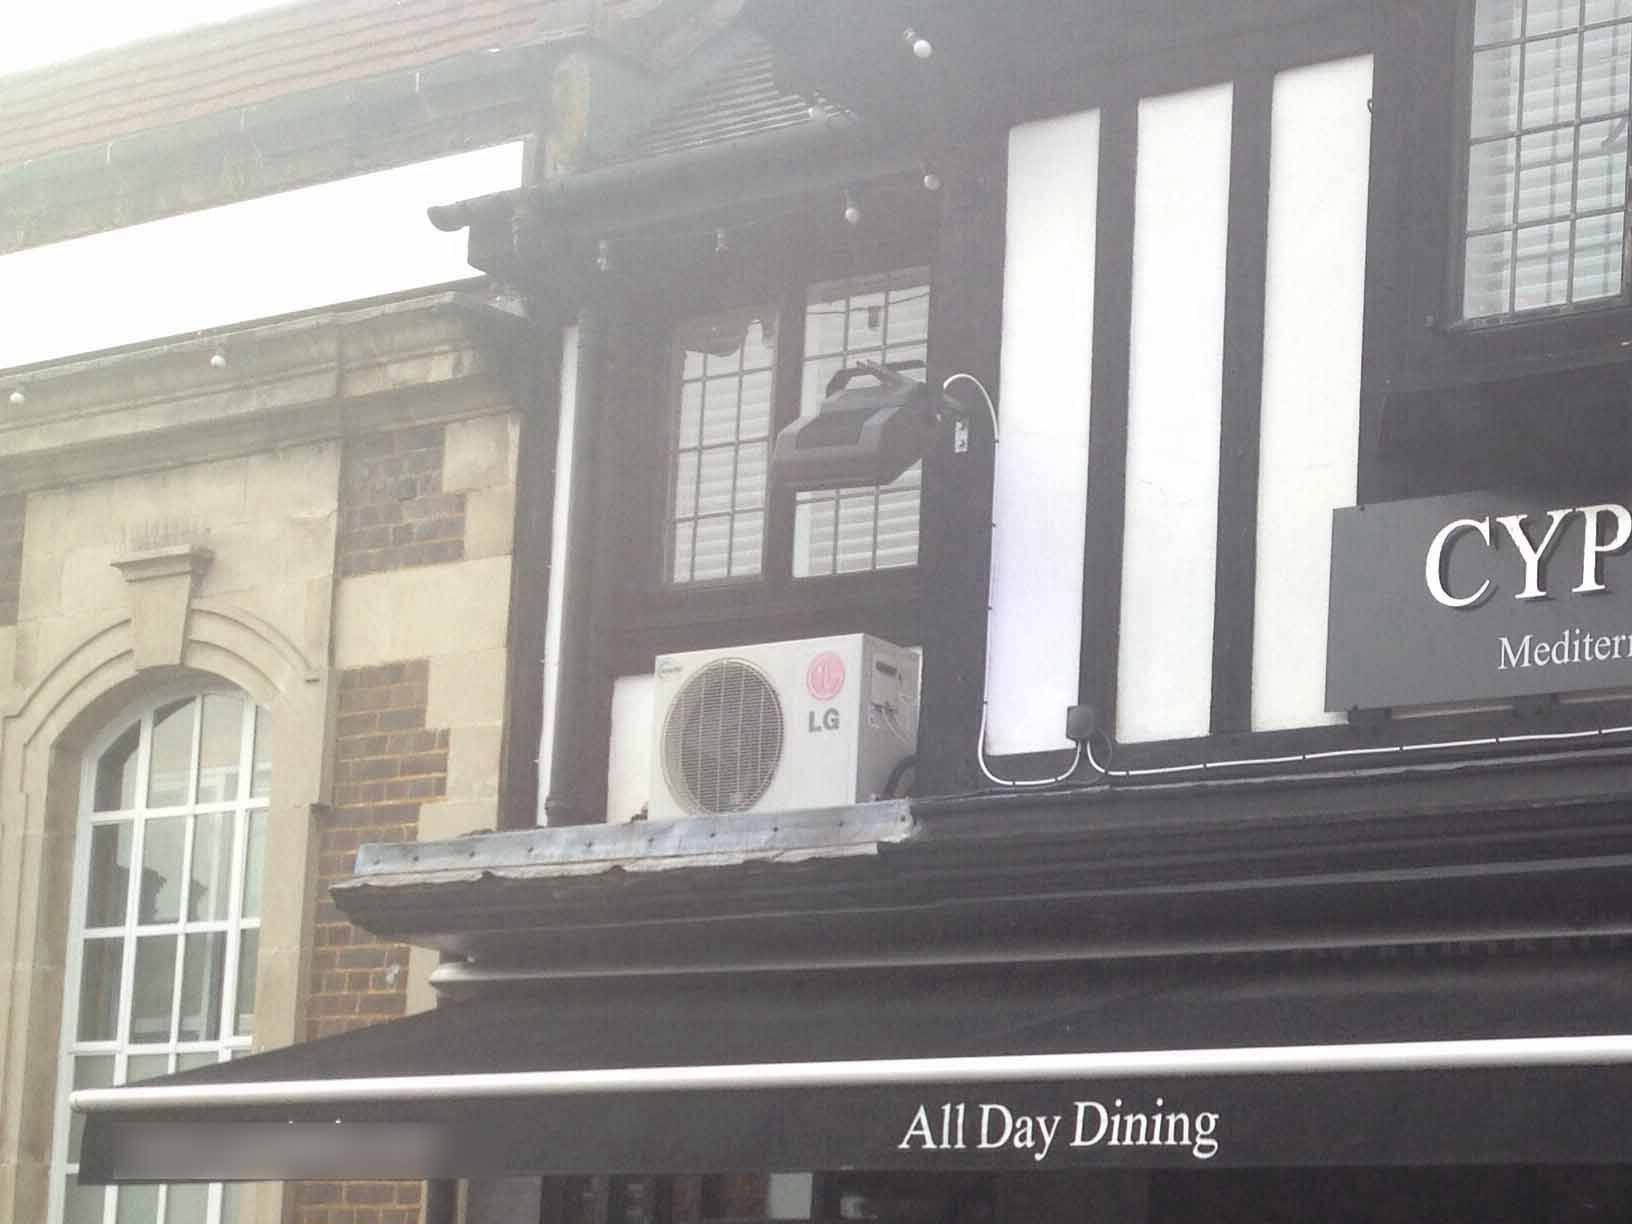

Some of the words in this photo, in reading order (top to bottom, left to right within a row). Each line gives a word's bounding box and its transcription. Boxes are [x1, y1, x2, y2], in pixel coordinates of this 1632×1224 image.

[807, 708, 840, 732] LG
[897, 1102, 967, 1149] All
[976, 1103, 1062, 1161] Day
[1069, 1097, 1220, 1159] Dining
